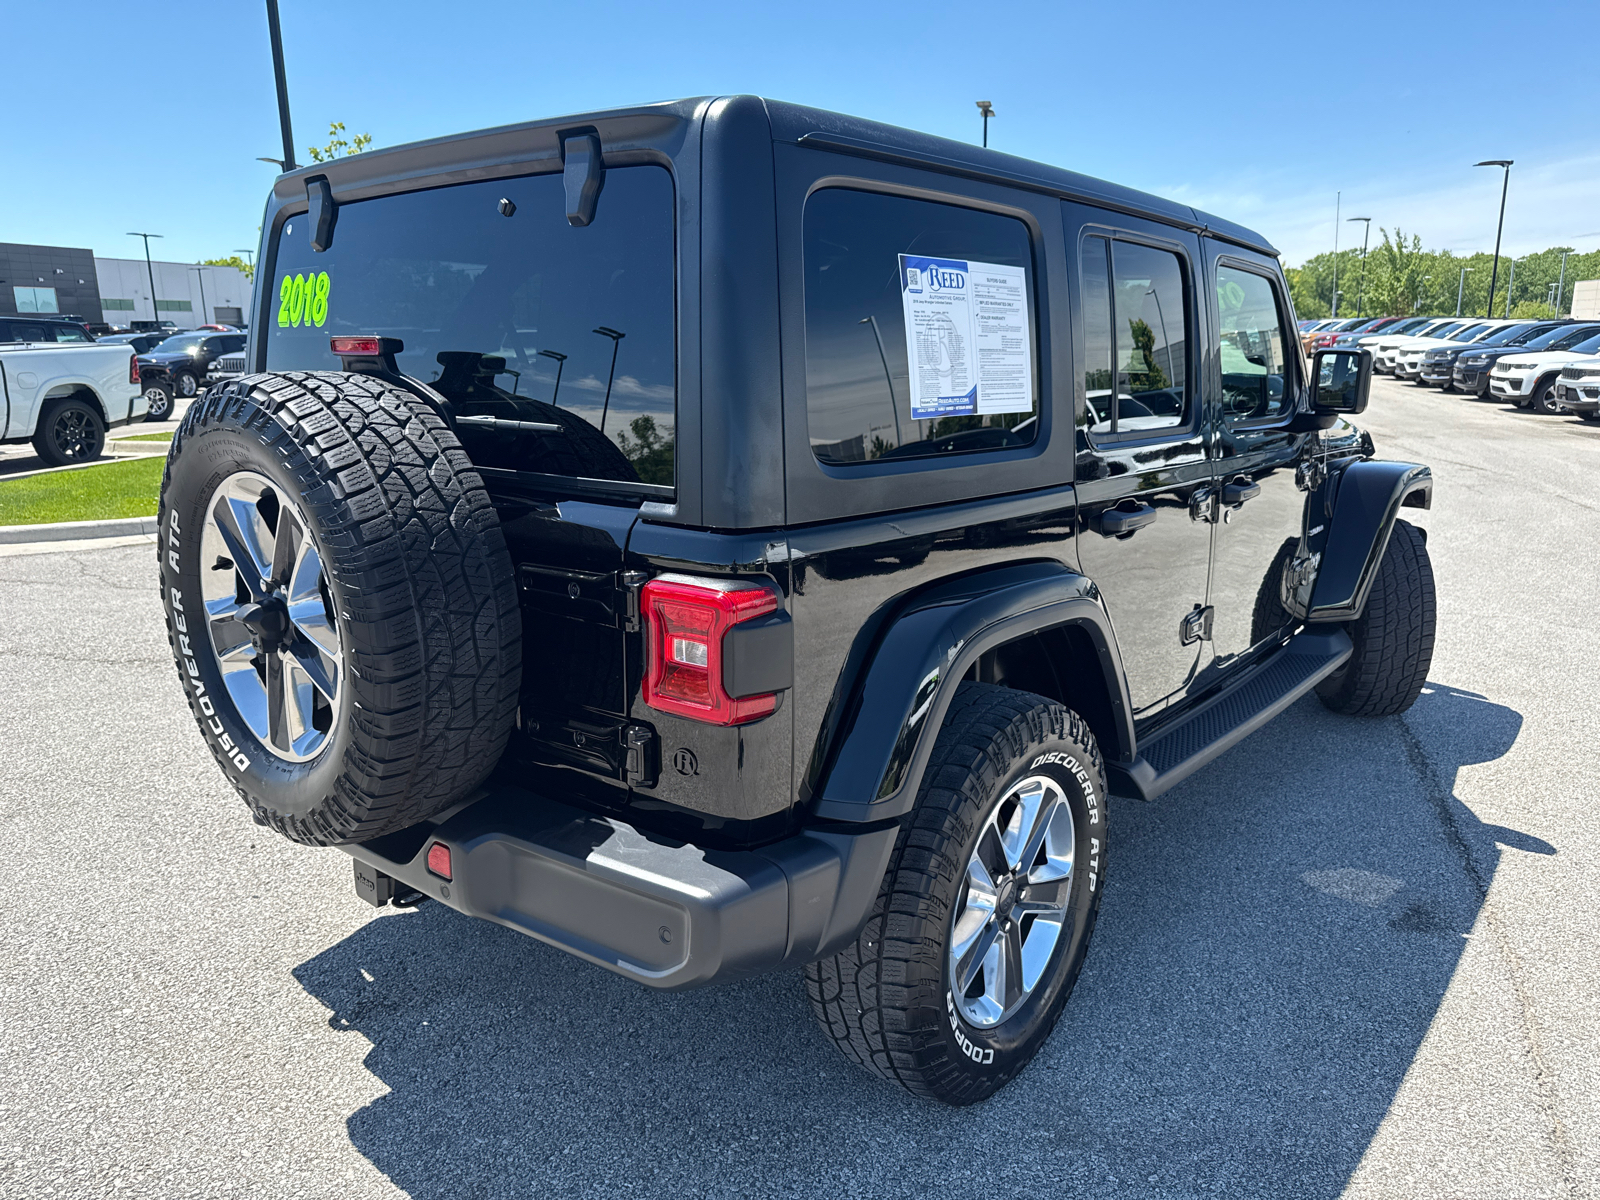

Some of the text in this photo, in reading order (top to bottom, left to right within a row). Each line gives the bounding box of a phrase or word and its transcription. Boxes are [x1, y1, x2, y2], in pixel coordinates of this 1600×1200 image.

[278, 271, 330, 328] 2018
[928, 267, 966, 290] REED
[168, 508, 251, 773] DISCOVERER ATP
[1029, 751, 1100, 893] DISCOVERER ATP
[356, 872, 375, 892] Jeep
[946, 989, 995, 1065] COOPER
